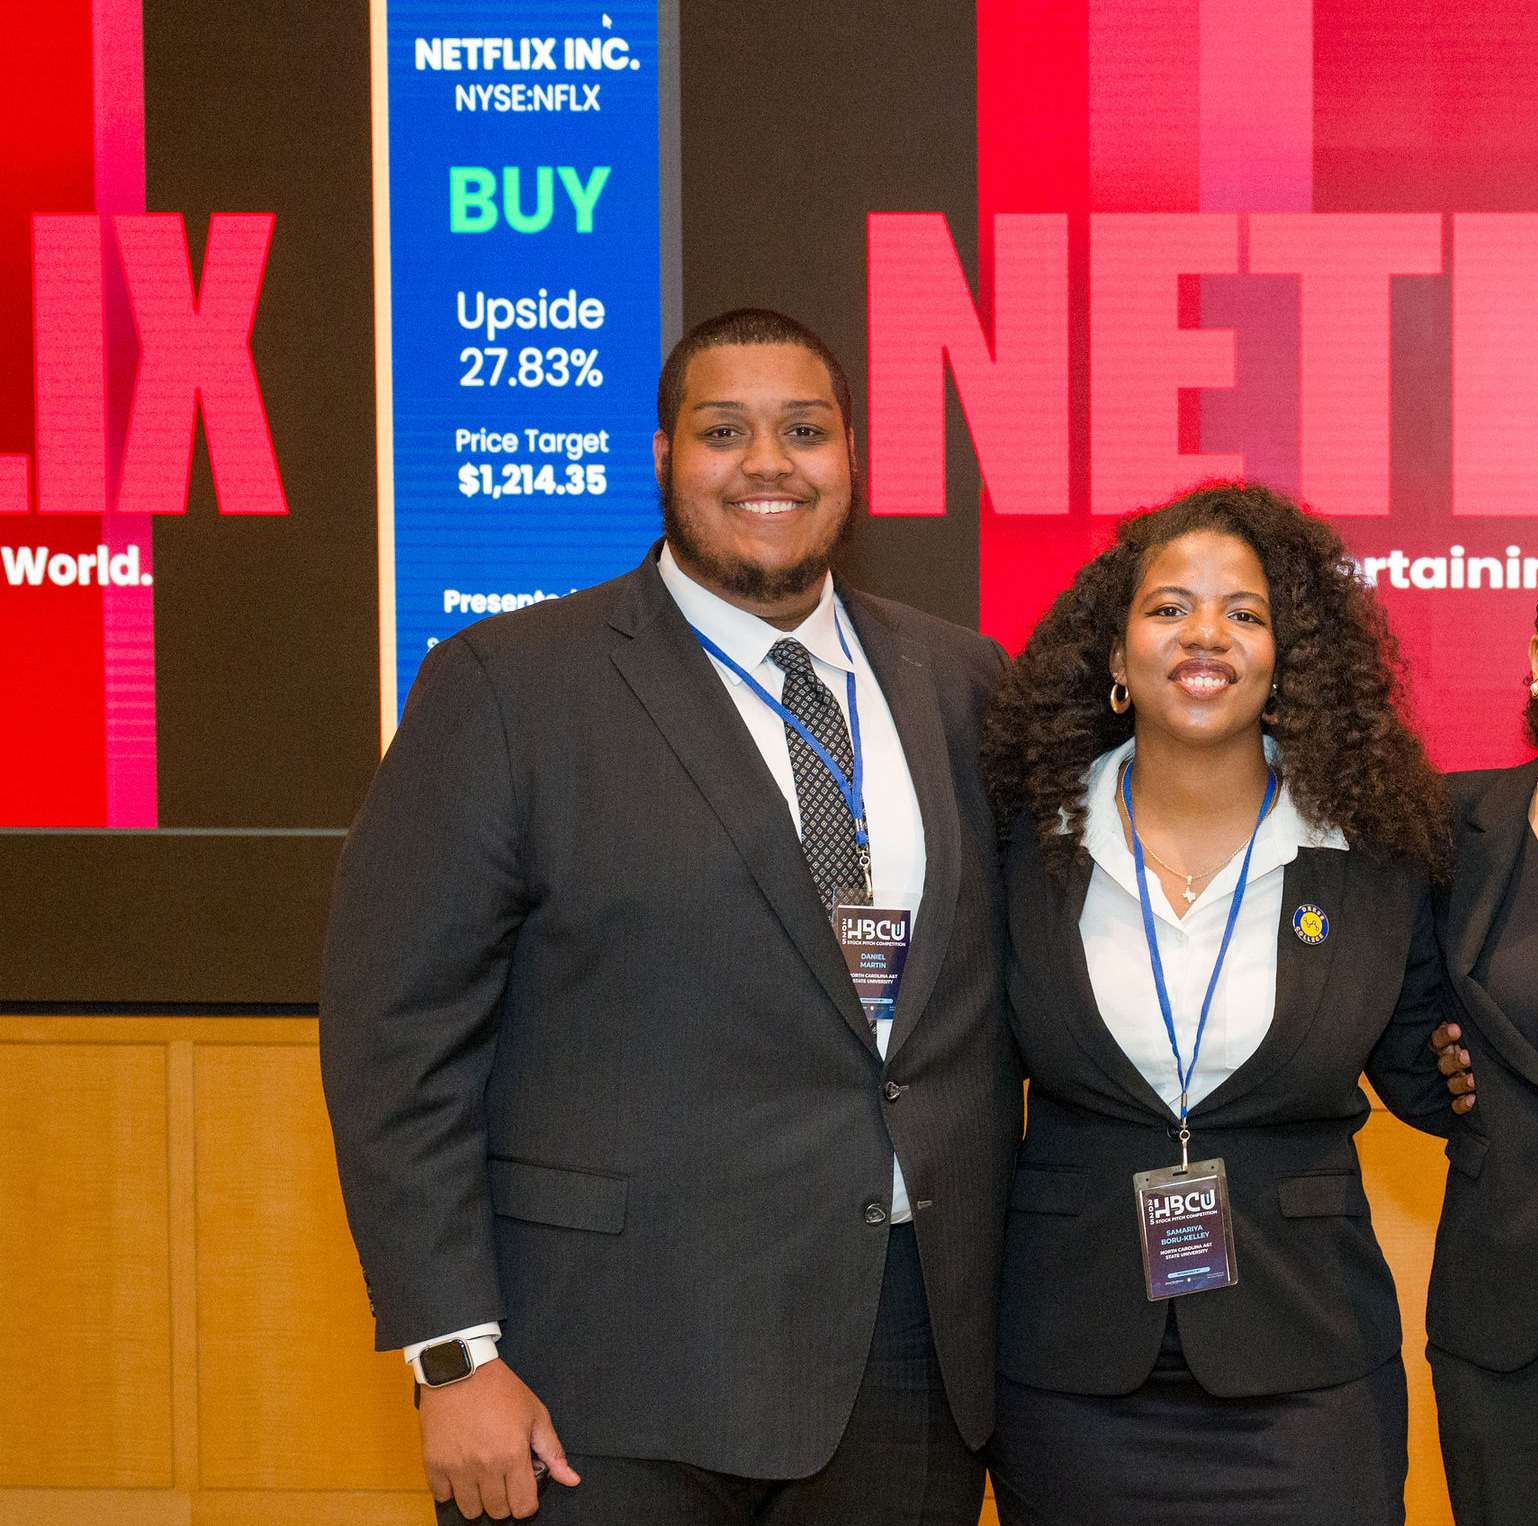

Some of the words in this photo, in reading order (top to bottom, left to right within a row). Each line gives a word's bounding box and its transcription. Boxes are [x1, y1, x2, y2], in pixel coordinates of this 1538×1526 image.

[415, 37, 557, 71] NETFLIX
[564, 37, 641, 71] INC.
[455, 83, 601, 112] NYSE:NFLX
[450, 166, 611, 233] BUY
[457, 288, 605, 341] Upside
[459, 347, 604, 388] 27.83%
[455, 427, 519, 453] Price
[524, 429, 610, 461] Target
[458, 461, 607, 499] $1,214.35
[0, 545, 154, 586] World.
[847, 918, 906, 940] HBCU
[1154, 1190, 1216, 1218] HBCU
[1166, 1225, 1203, 1237] SAMARIYA
